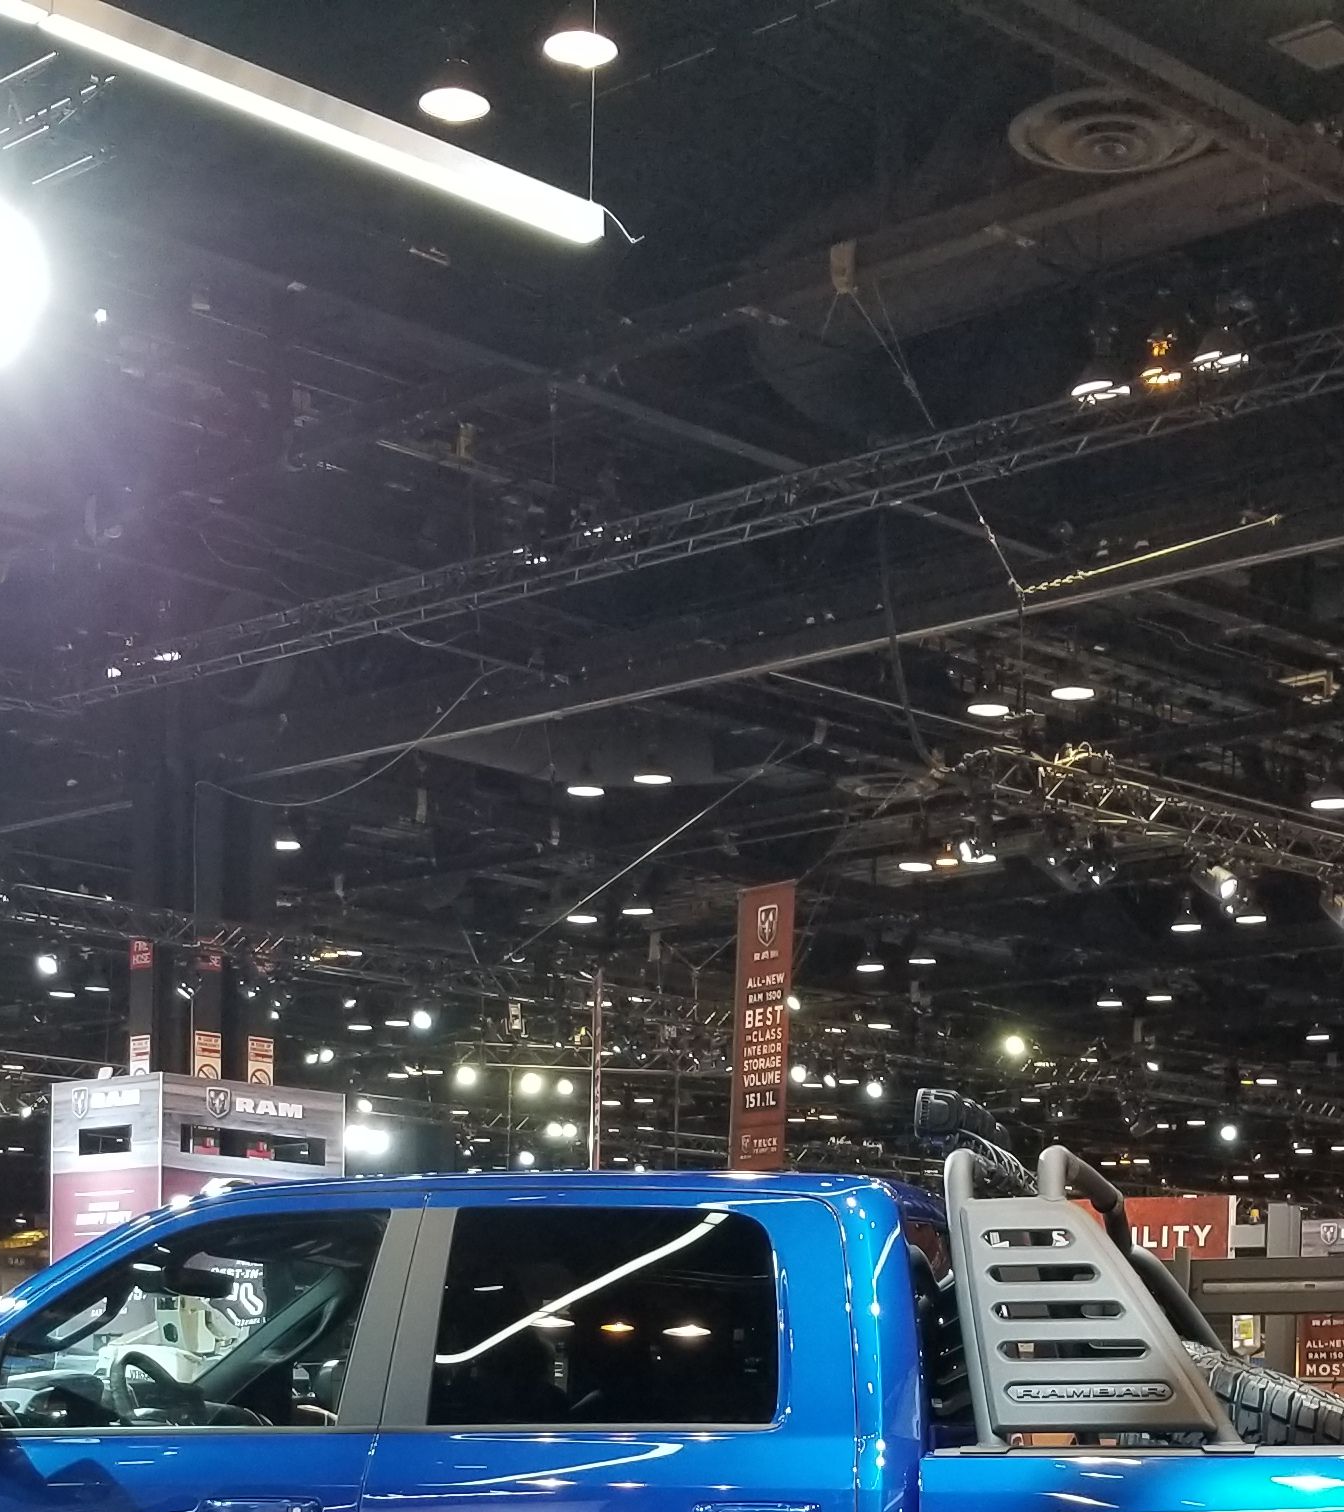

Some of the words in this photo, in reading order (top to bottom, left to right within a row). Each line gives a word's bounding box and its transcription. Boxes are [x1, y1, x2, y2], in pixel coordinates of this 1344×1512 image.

[753, 950, 779, 961] RAM
[747, 972, 785, 989] ALL-NEW
[748, 992, 764, 1004] RAM
[765, 989, 782, 1002] 1500
[745, 1005, 784, 1029] BEST
[752, 1027, 783, 1043] CLASS
[743, 1043, 783, 1058] INTERIOR
[743, 1056, 782, 1072] STORAGE
[743, 1070, 781, 1087] VOLUME
[234, 1098, 304, 1119] RAM
[745, 1091, 777, 1110] 151.1L
[1308, 1352, 1327, 1360] RAM
[1016, 1384, 1167, 1399] RAMBAR
